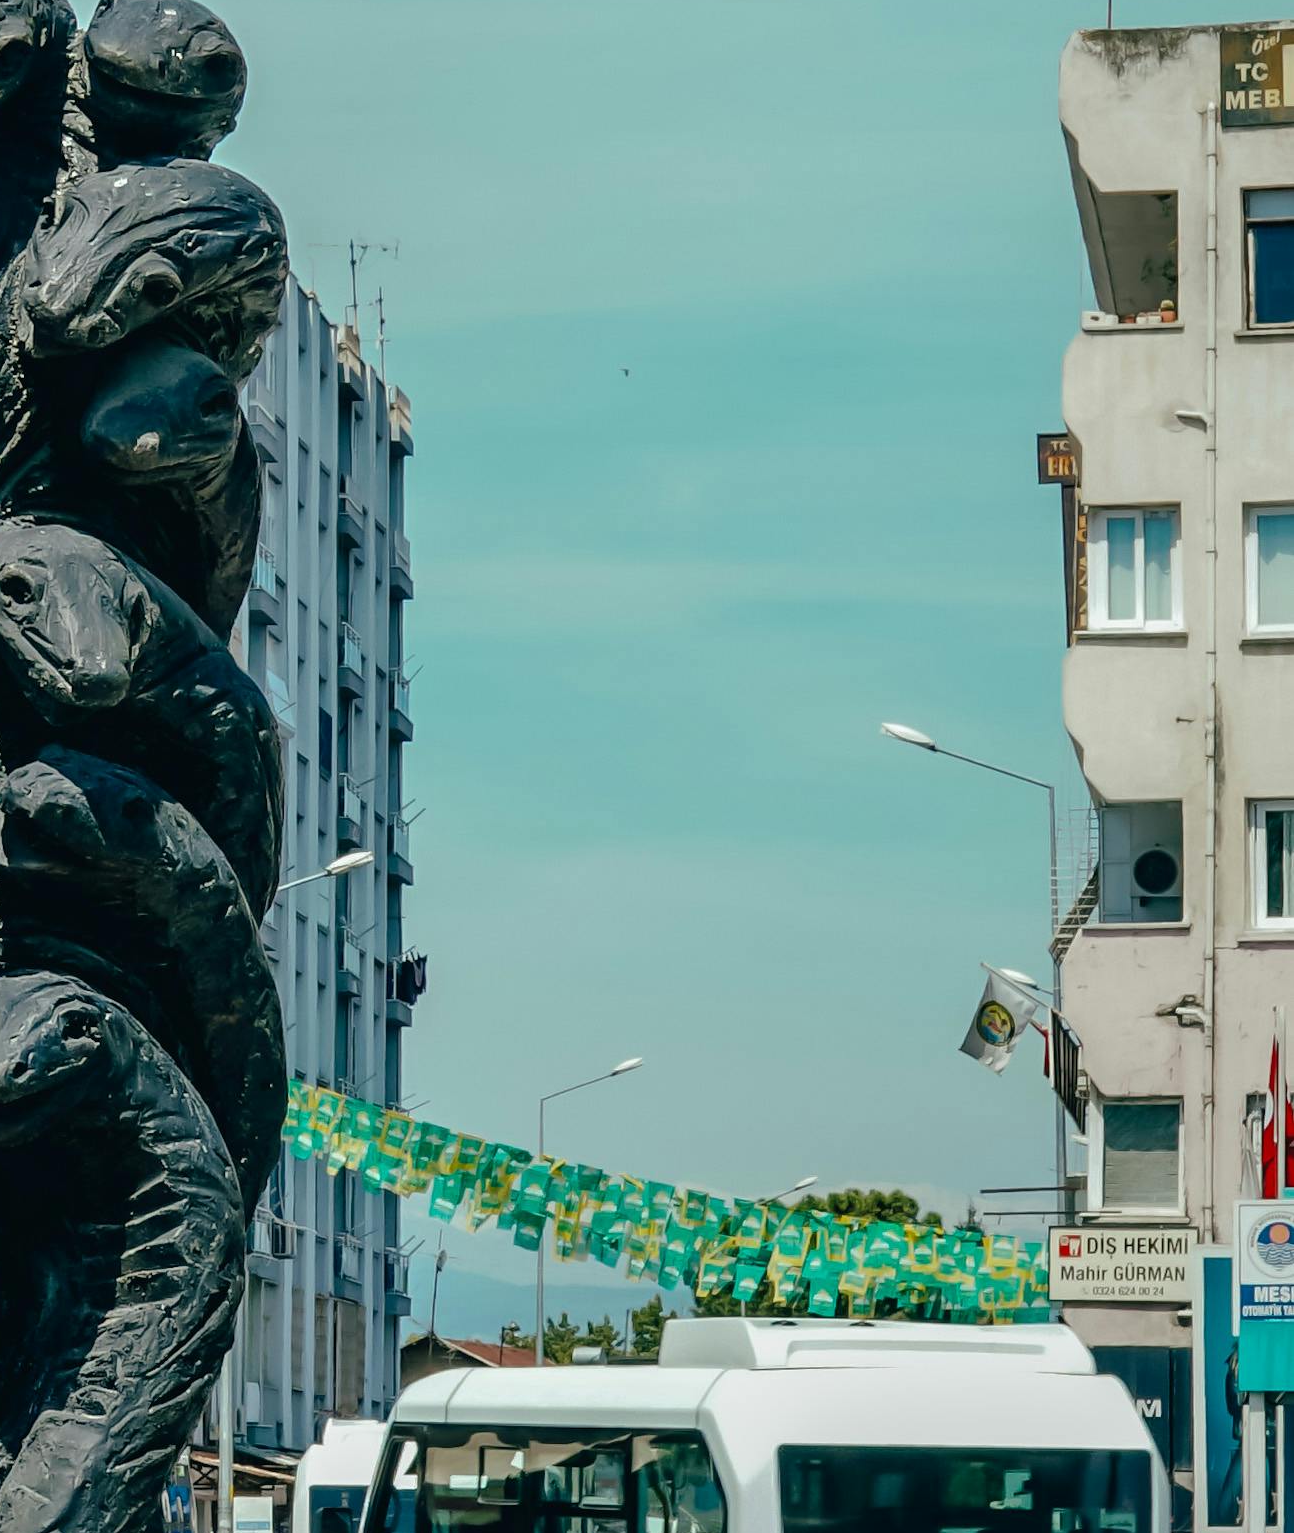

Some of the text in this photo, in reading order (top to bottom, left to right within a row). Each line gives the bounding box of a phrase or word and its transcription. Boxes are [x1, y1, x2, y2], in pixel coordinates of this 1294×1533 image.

[1252, 31, 1281, 55] Özel
[1235, 62, 1269, 82] TC
[1225, 89, 1281, 110] MEB
[1087, 1233, 1189, 1259] DİŞ HEKİMİ
[1061, 1263, 1185, 1282] Mahir GÜRMAN
[1092, 1286, 1115, 1296] 0324
[1118, 1286, 1136, 1296] 624
[1153, 1286, 1164, 1296] 24
